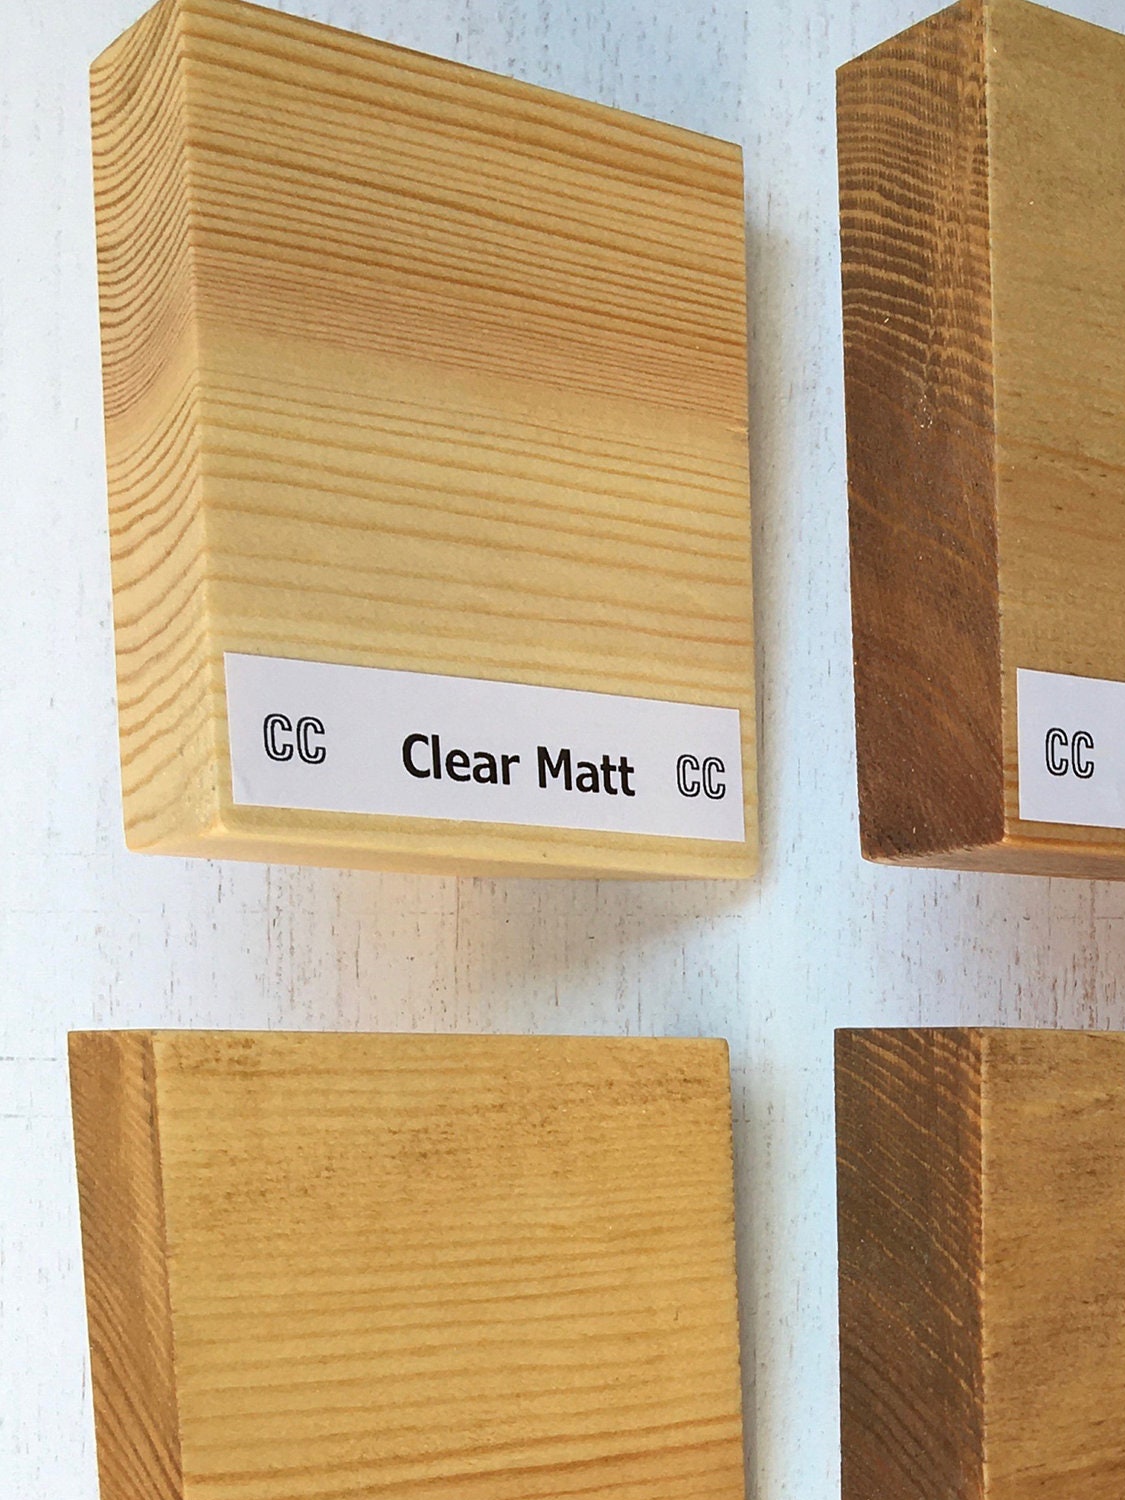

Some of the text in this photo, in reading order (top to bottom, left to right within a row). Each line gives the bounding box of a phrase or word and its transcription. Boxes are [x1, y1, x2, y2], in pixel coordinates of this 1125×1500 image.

[262, 712, 727, 801] CC Clear Matt CC
[1044, 727, 1095, 780] CC
